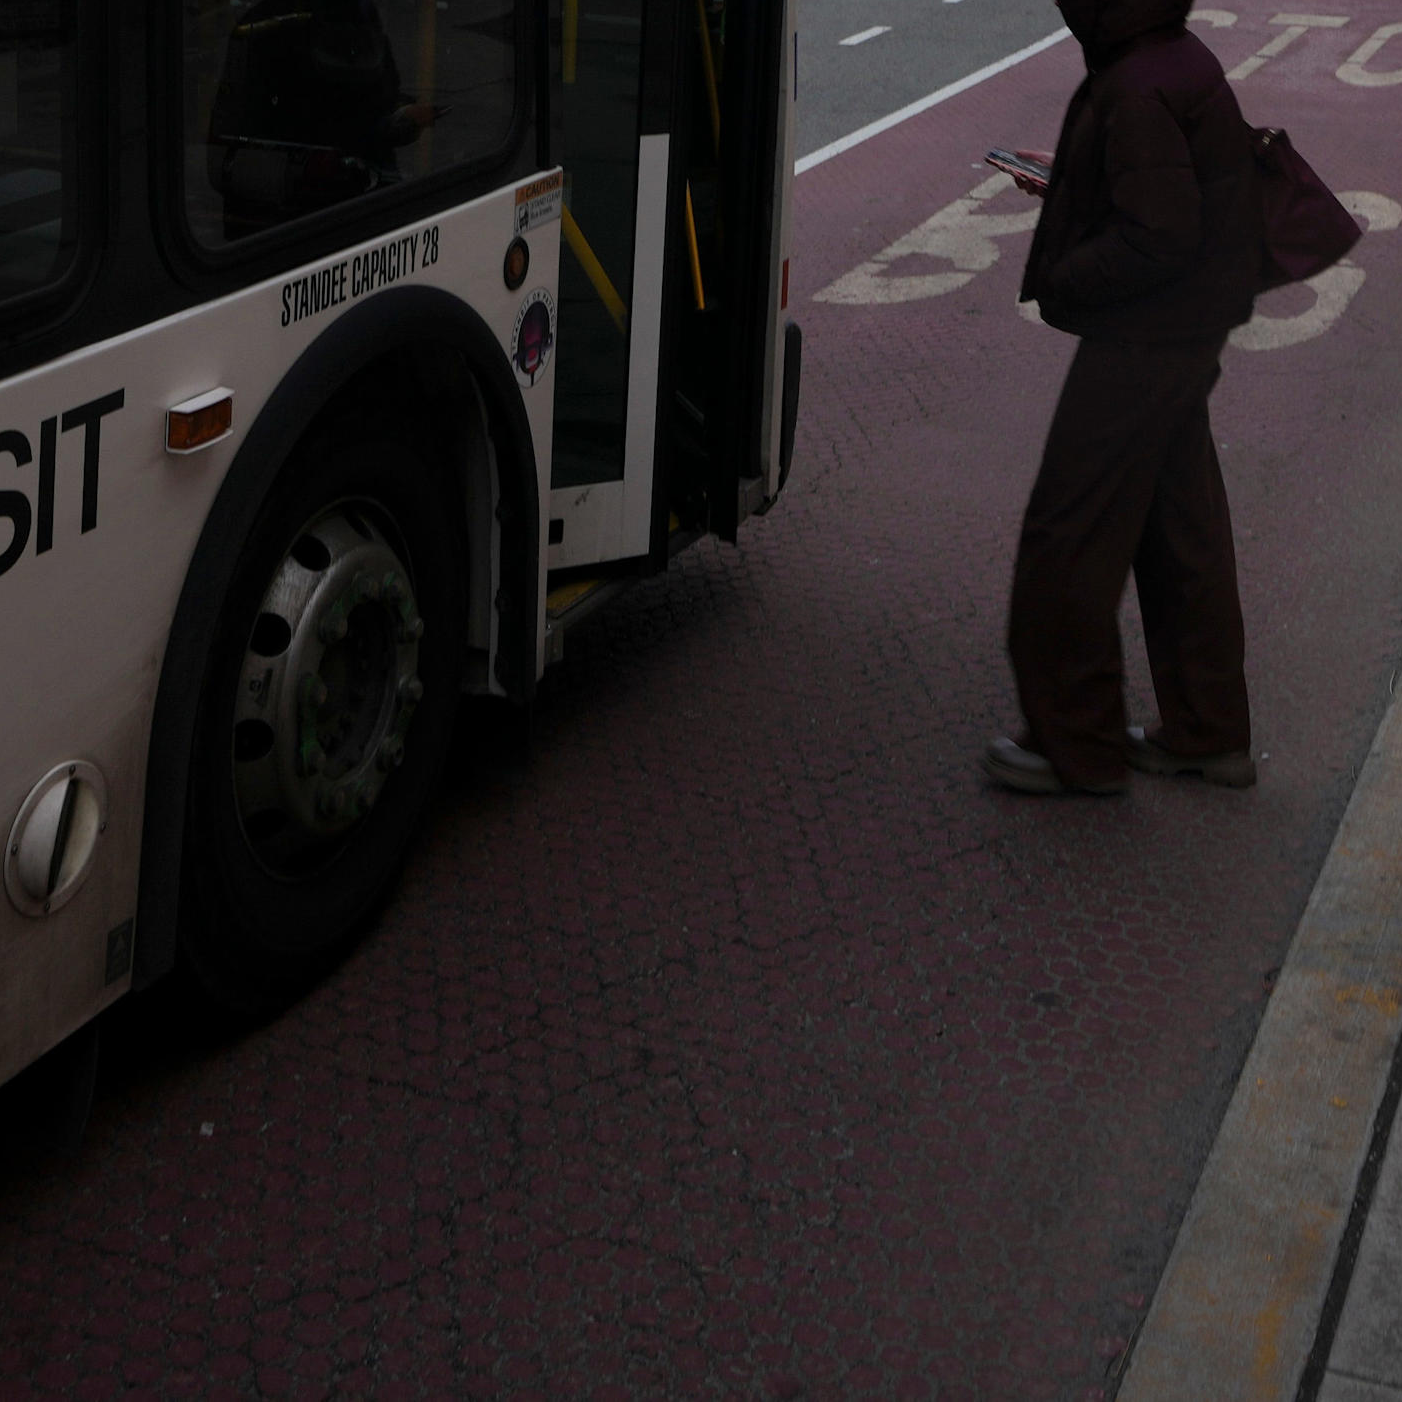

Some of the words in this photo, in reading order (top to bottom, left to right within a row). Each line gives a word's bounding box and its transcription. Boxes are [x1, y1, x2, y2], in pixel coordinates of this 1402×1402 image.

[281, 261, 348, 327] STANDEE
[351, 233, 419, 299] CAPACITY
[422, 225, 440, 270] 28
